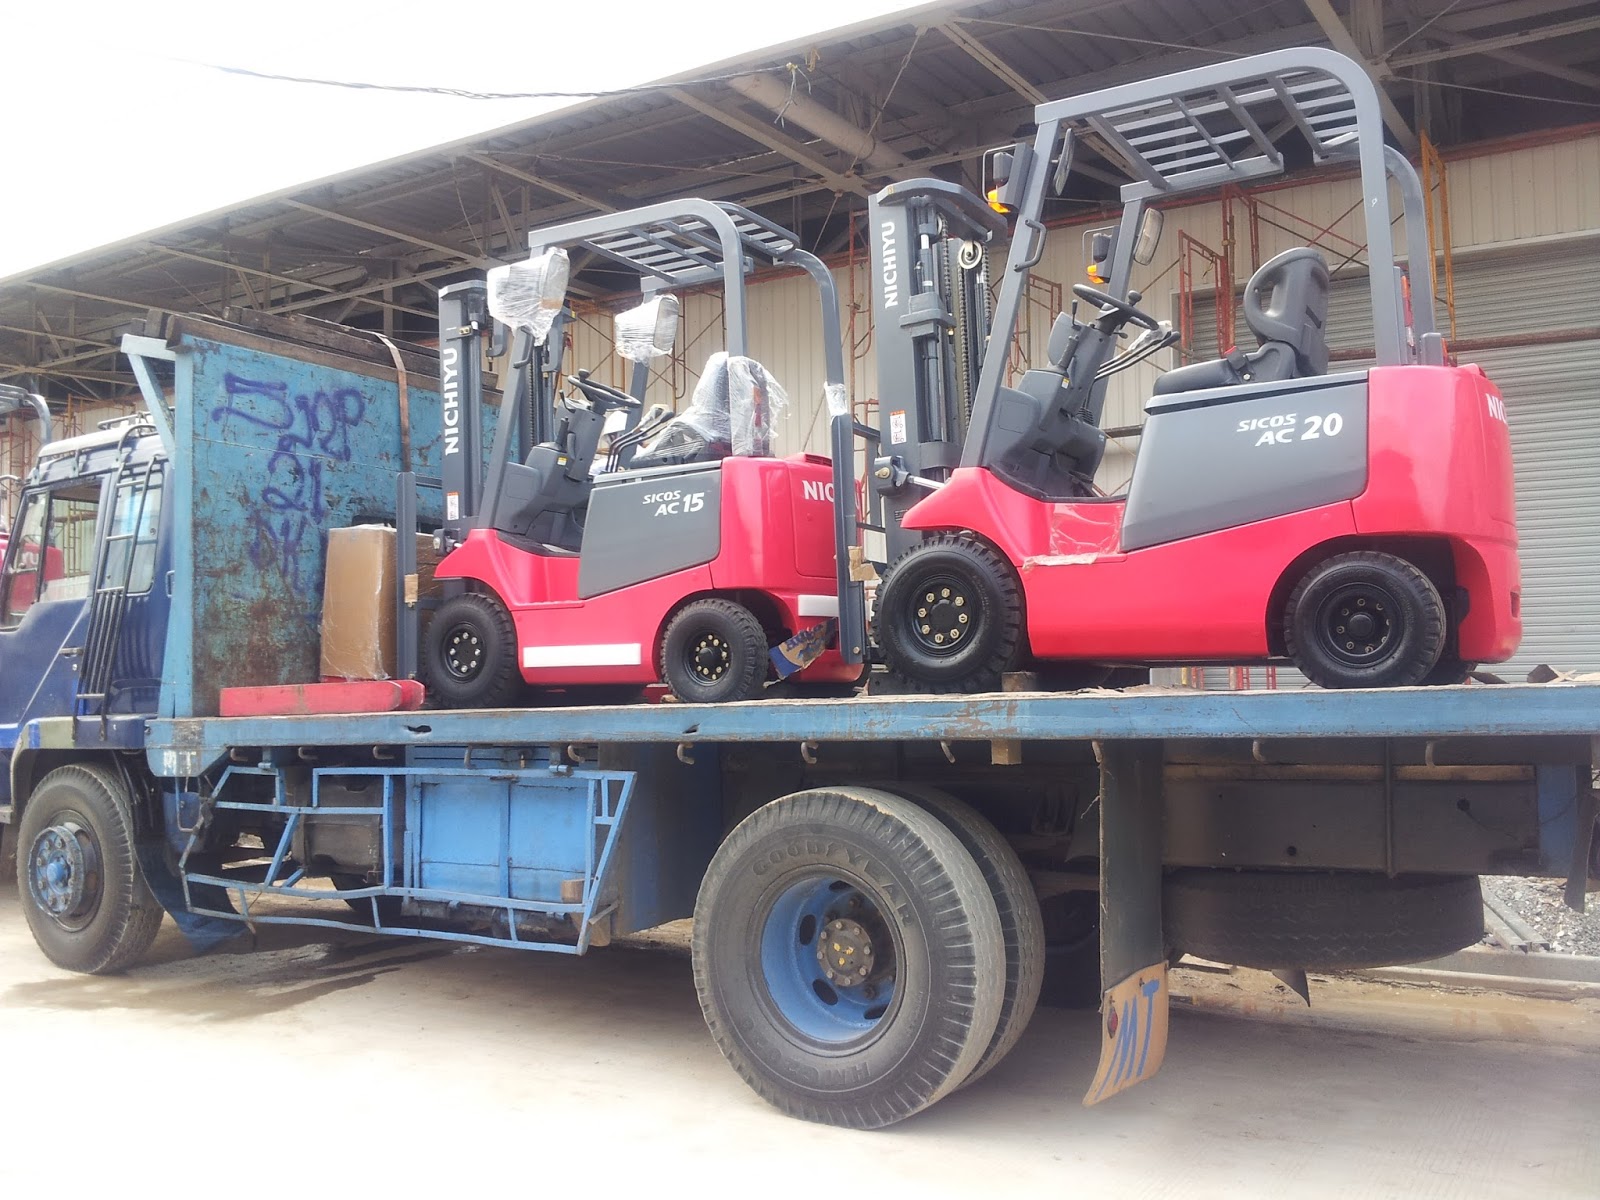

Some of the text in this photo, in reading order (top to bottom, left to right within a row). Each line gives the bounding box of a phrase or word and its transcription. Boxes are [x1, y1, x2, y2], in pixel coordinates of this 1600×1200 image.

[881, 220, 899, 309] NICHIYU
[442, 347, 459, 456] NICHIYU
[1236, 413, 1297, 432] SICOS
[1254, 412, 1343, 446] AC 20
[642, 490, 681, 504] SICOS
[654, 492, 705, 516] AC 15
[801, 480, 835, 503] NIC
[752, 839, 914, 928] GOODYEAR
